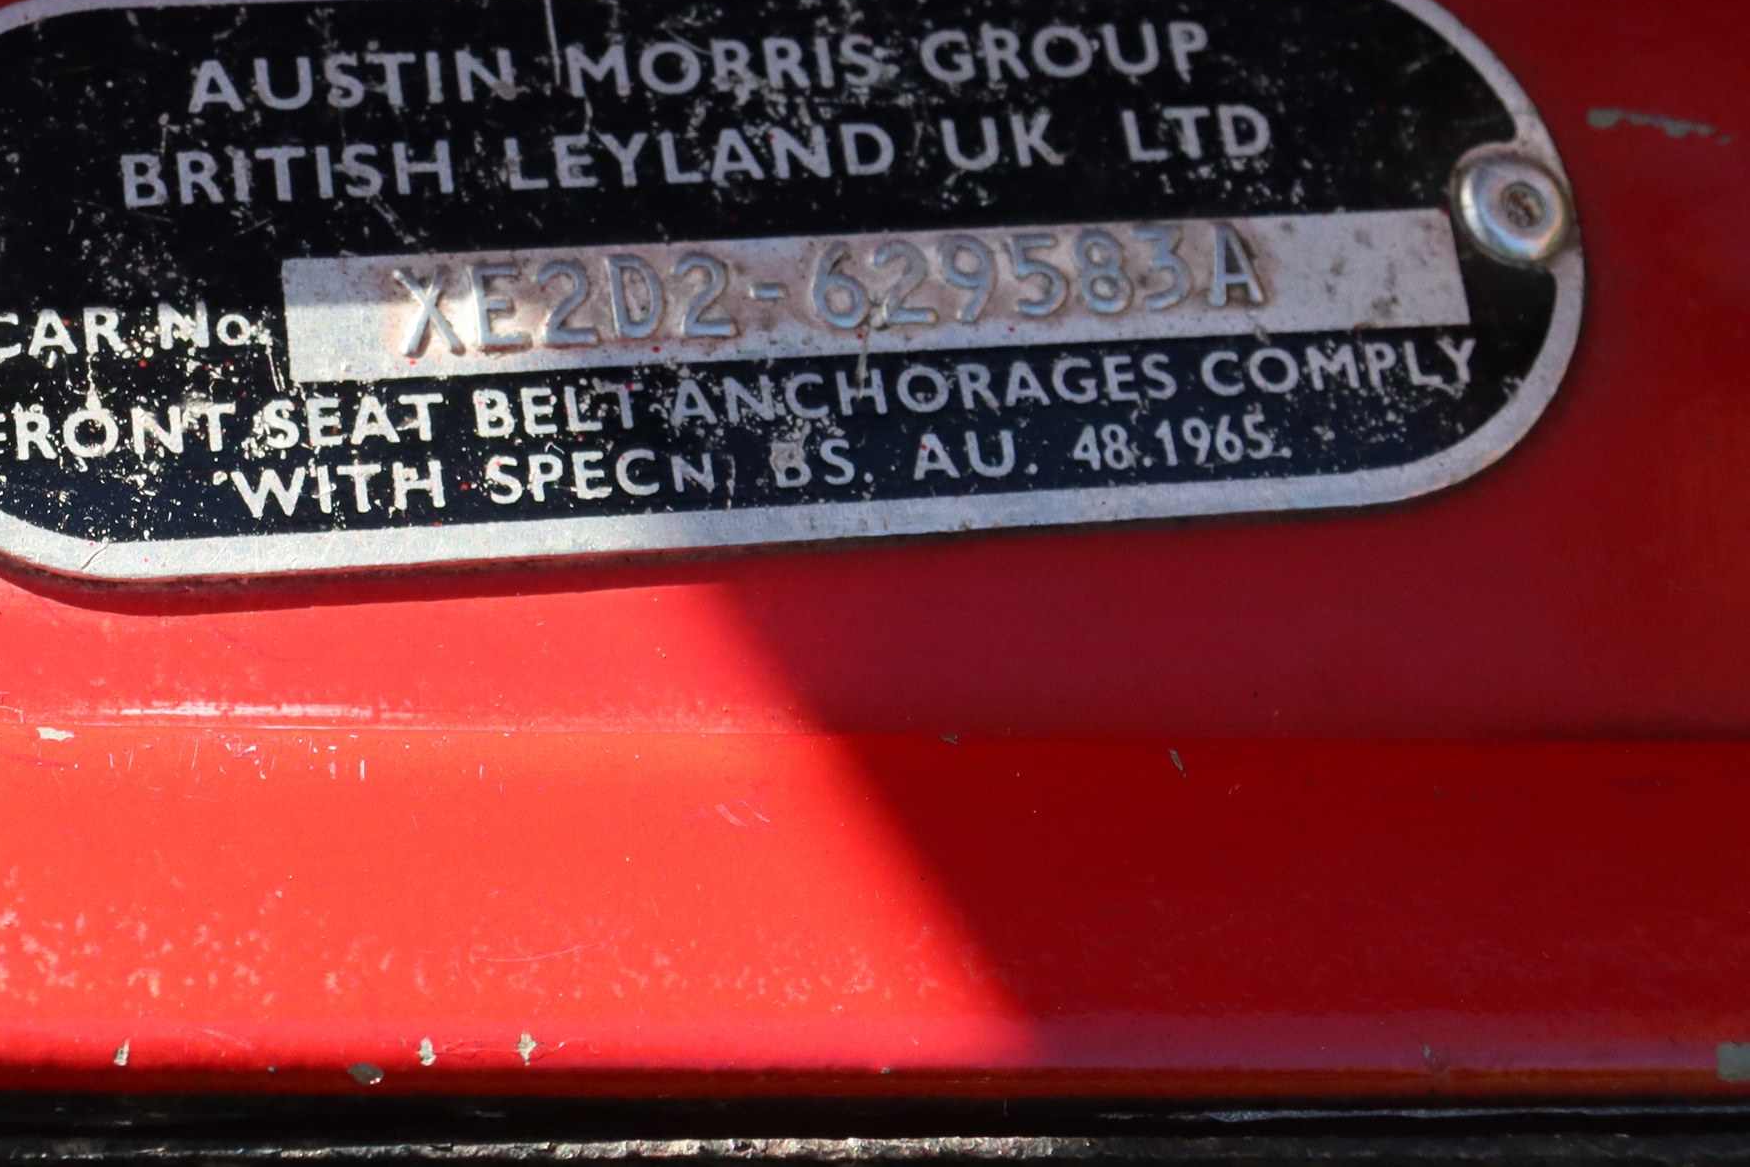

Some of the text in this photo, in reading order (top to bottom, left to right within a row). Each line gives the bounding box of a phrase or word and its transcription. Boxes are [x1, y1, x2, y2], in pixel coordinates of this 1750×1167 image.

[187, 20, 1209, 114] AUSTIN MORRIS GROUP
[121, 104, 1271, 208] BRITISH LEYLAND UK LTD
[392, 220, 1266, 359] XE2D2-629583A
[261, 392, 445, 451] SEAT
[473, 380, 643, 438] BELT
[669, 353, 1179, 427] ANCHORAGES
[1201, 337, 1477, 405] COMPLY
[230, 459, 447, 519] WITH
[912, 430, 1039, 481] AU.
